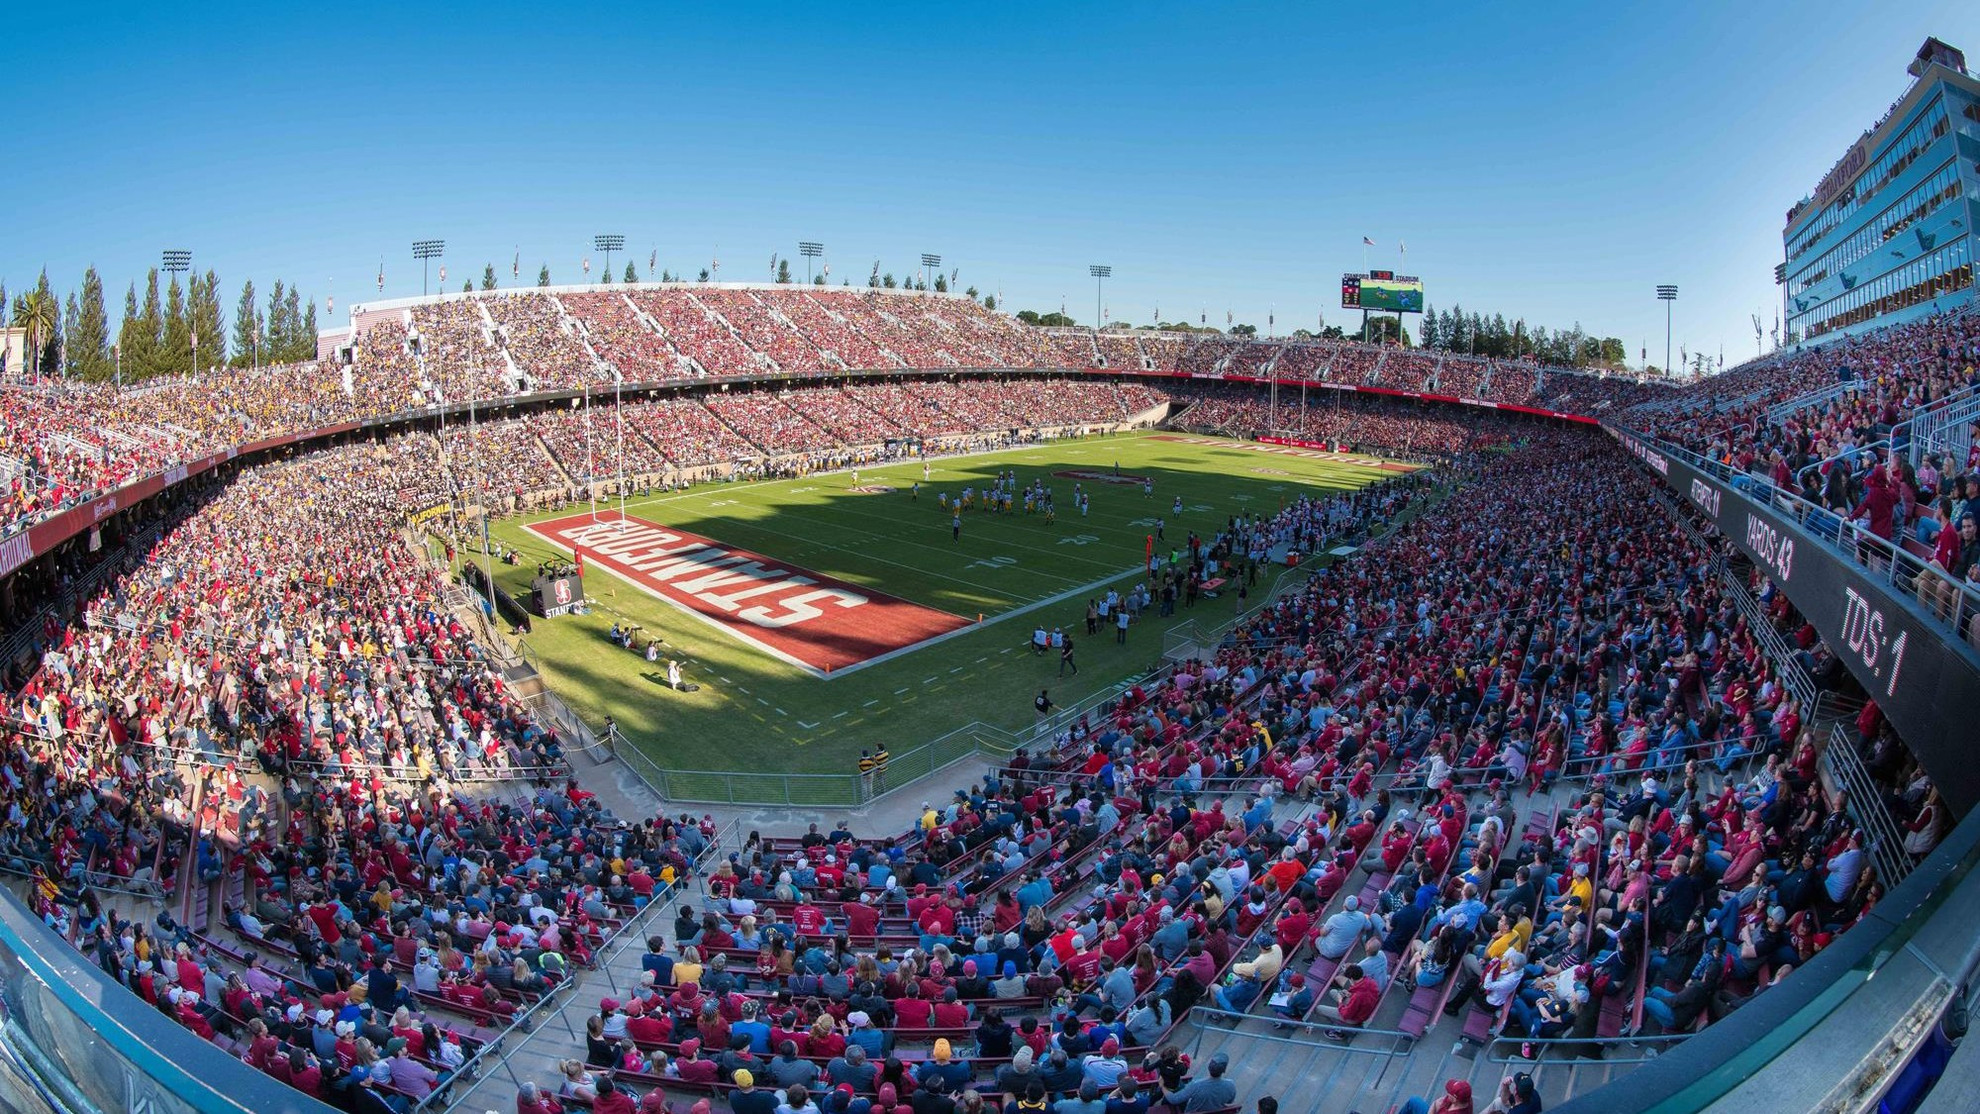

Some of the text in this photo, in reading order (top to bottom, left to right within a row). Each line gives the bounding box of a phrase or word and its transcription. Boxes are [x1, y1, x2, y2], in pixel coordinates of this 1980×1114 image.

[1819, 145, 1866, 205] STANFORD
[411, 502, 450, 523] ALIFORNIA
[557, 519, 869, 628] STANFORD
[1746, 513, 1794, 581] YARDS: 43
[545, 602, 575, 620] STANF
[1841, 587, 1908, 697] TDS: 1
